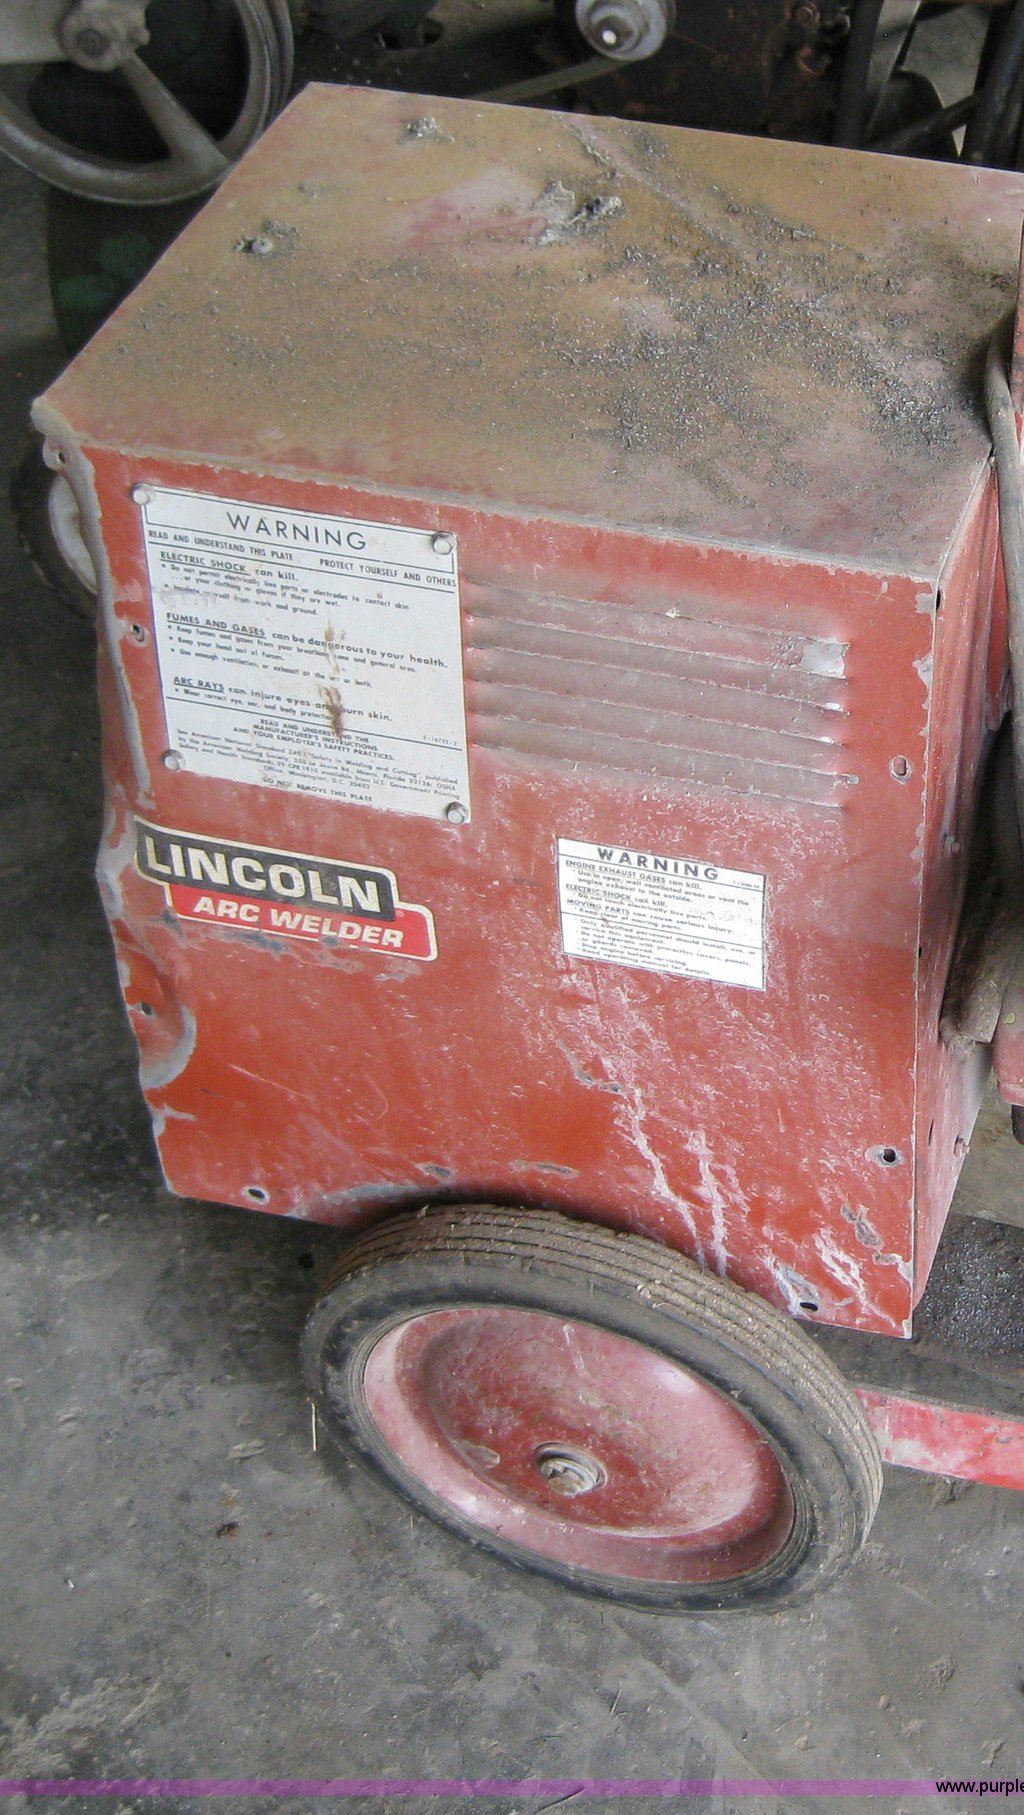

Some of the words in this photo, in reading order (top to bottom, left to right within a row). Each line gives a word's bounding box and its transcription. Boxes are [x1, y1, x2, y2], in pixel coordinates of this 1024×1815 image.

[226, 512, 365, 550] WARNING
[147, 529, 168, 539] READ
[172, 533, 189, 543] AND
[193, 537, 245, 552] UNDERSTAND
[248, 545, 266, 556] THIS
[270, 549, 293, 561] PLATE
[319, 557, 353, 570] PROTECT
[358, 564, 397, 577] YOURSELF
[403, 571, 421, 581] AND
[425, 574, 456, 587] OTHERS
[160, 550, 204, 565] ELECTRIC
[210, 558, 245, 572] SHOCK
[254, 568, 273, 577] can
[277, 570, 298, 581] kill.
[169, 563, 180, 572] Do
[198, 569, 220, 578] permit
[223, 573, 260, 586] electrically
[263, 579, 276, 588] live
[279, 584, 298, 592] parts
[313, 588, 348, 600] electrodes
[364, 598, 390, 607] contact
[394, 601, 409, 610] skin
[165, 611, 200, 624] FUMES
[204, 618, 227, 629] AND
[231, 623, 265, 636] GASES
[271, 632, 290, 641] can
[291, 633, 305, 643] be
[307, 637, 363, 653] dangerous
[365, 647, 377, 656] to
[379, 651, 405, 660] your
[409, 653, 447, 668] health.
[173, 675, 192, 686] ARC
[197, 679, 224, 692] RAYS
[227, 686, 247, 695] can
[250, 688, 282, 701] injure
[285, 697, 310, 706] eyes
[314, 702, 337, 712] an
[367, 710, 392, 721] skin.
[259, 718, 279, 727] READ
[282, 722, 299, 730] AND
[301, 726, 352, 740] UNDERSTND
[355, 735, 369, 743] THE
[299, 710, 334, 723] protectio
[329, 788, 346, 797] THIS
[349, 793, 372, 802] PLATE
[144, 836, 381, 912] LINCOLN
[565, 859, 595, 871] ENGINE
[598, 865, 636, 878] EXHAUST
[638, 872, 665, 884] GASES
[685, 881, 701, 890] kill.
[597, 847, 718, 881] WARNING
[565, 883, 600, 895] ELECTRIC
[602, 889, 631, 901] SHOCK
[651, 898, 667, 907] kill.
[193, 896, 261, 922] ARC
[270, 908, 404, 948] WELDER
